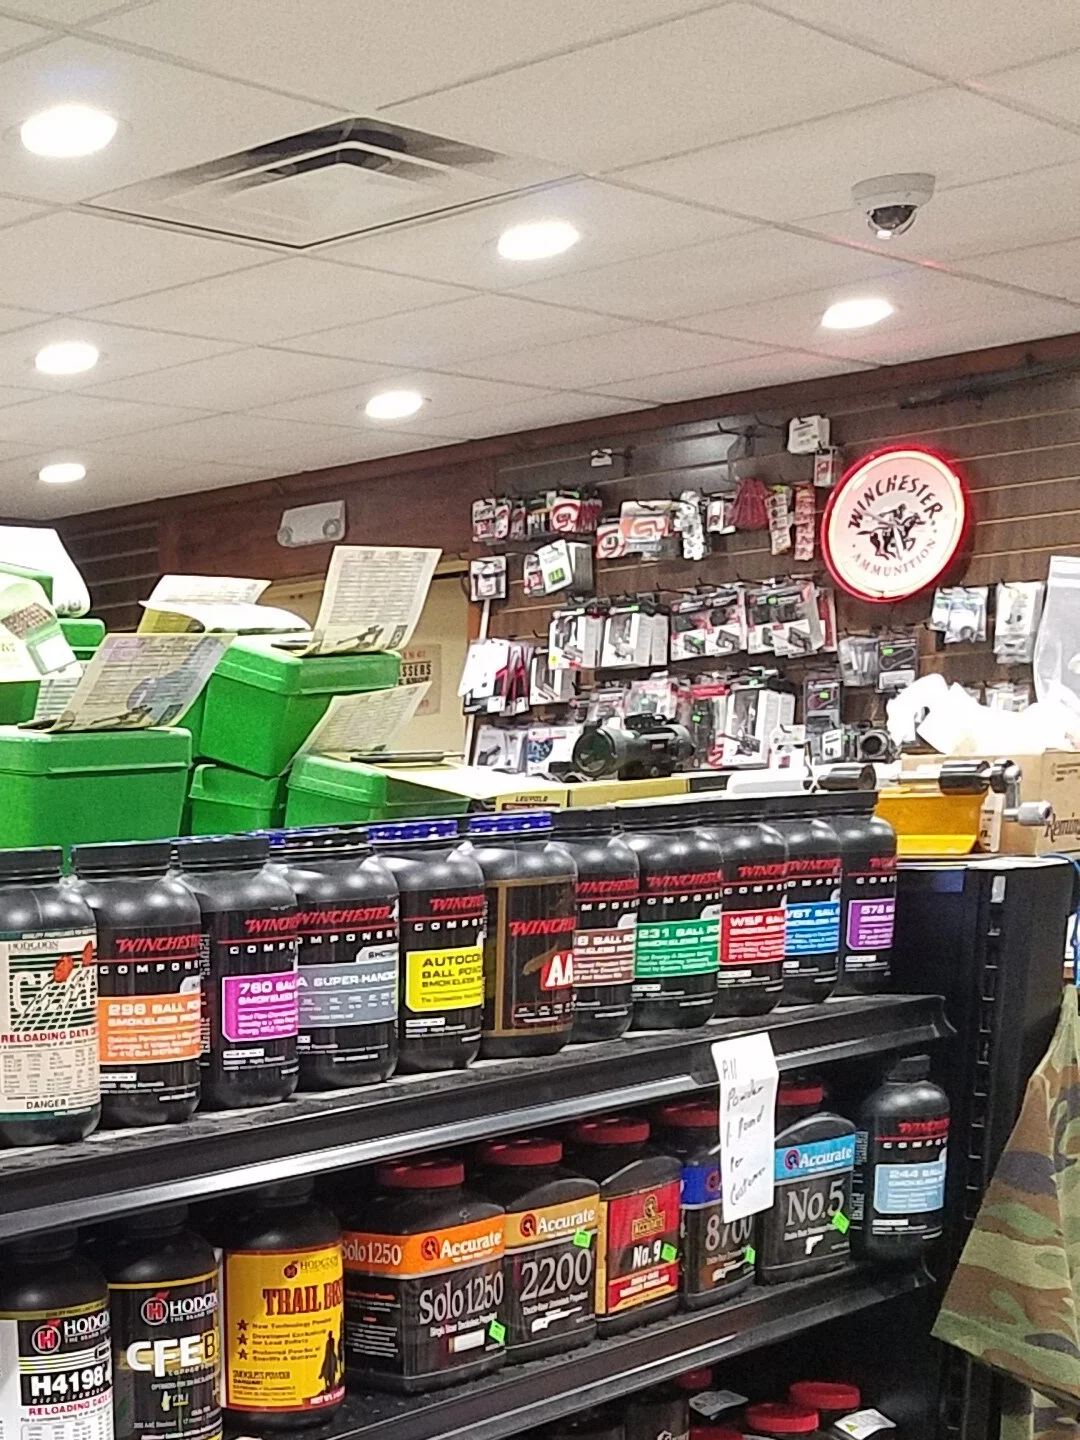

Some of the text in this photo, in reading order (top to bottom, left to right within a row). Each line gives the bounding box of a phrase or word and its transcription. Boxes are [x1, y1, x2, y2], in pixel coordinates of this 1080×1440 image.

[848, 475, 943, 530] WINCHESTER
[852, 538, 936, 577] AMMUNITION
[730, 915, 763, 927] WSF
[239, 983, 271, 995] 760
[152, 1002, 183, 1014] BALL
[0, 1033, 66, 1044] RELOADING
[25, 1099, 67, 1110] DANGER
[799, 1147, 853, 1170] Accurate
[539, 1209, 596, 1234] Accurate
[440, 1231, 502, 1258] Accurate
[520, 1249, 592, 1301] 2200
[262, 1284, 318, 1316] TRAIL
[126, 1335, 202, 1377] CFE
[31, 1366, 103, 1397] H4198
[28, 1399, 91, 1417] RELOADING
